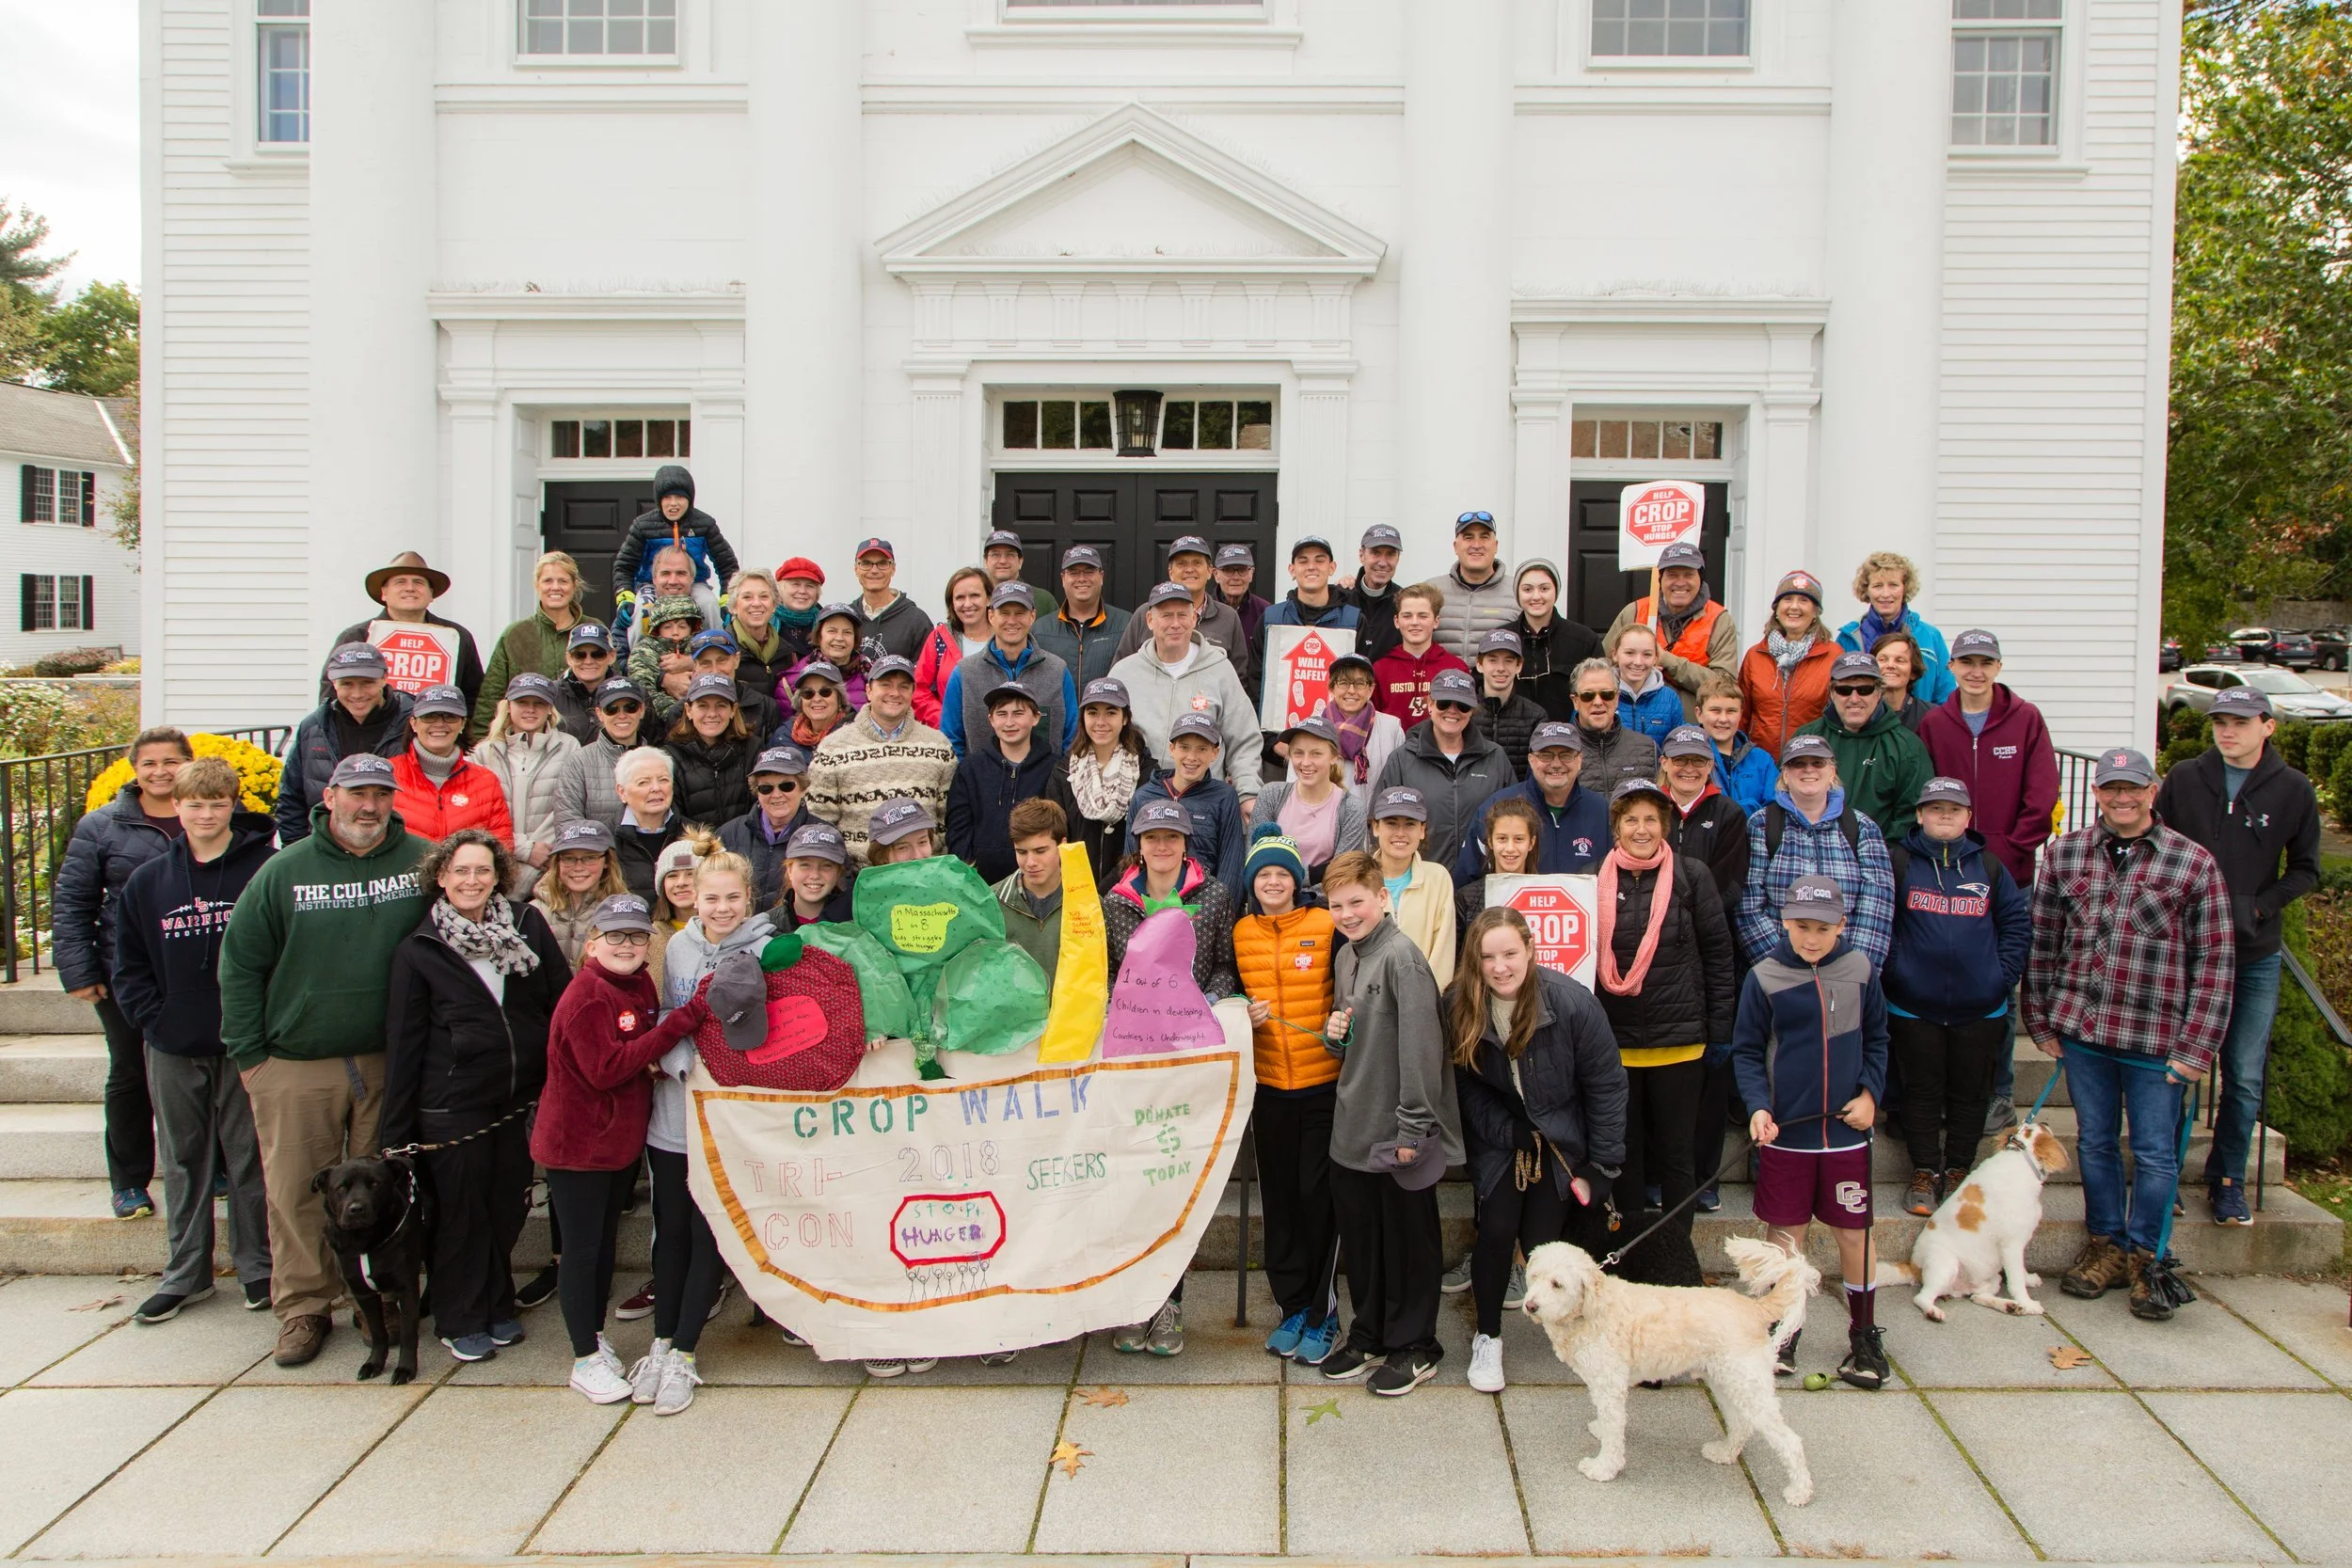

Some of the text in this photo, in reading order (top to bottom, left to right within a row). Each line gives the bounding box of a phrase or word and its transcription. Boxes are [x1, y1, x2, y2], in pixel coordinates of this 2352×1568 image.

[1653, 491, 1675, 499] HELP
[1634, 501, 1690, 524] CROP
[1643, 531, 1677, 541] HUNGER
[1651, 524, 1673, 532] STOP
[400, 639, 424, 649] HELP
[1297, 657, 1325, 669] WALK
[396, 680, 421, 691] STOP
[1294, 669, 1327, 681] SAFELY
[2112, 754, 2127, 767] B
[294, 884, 329, 901] THE
[294, 898, 355, 912] INSTITUTE
[373, 887, 422, 904] AMERICA
[1529, 895, 1557, 908] HELP
[1911, 892, 1986, 915] PATRIOTS
[895, 918, 903, 931] 1
[920, 918, 930, 931] 8
[1525, 914, 1580, 943] ROP
[1122, 968, 1179, 989] 1 out of 6
[1116, 998, 1149, 1014] Children
[1166, 1006, 1203, 1019] developing
[1112, 1026, 1144, 1041] Countries
[793, 1075, 1091, 1138] CROP WALK
[1135, 1103, 1190, 1126] DONATE
[898, 1140, 1000, 1182] 2018
[1026, 1152, 1107, 1191] SEEKERS
[1143, 1161, 1191, 1187] TODAY
[764, 1212, 853, 1251] CON
[901, 1224, 981, 1249] HUNGER
